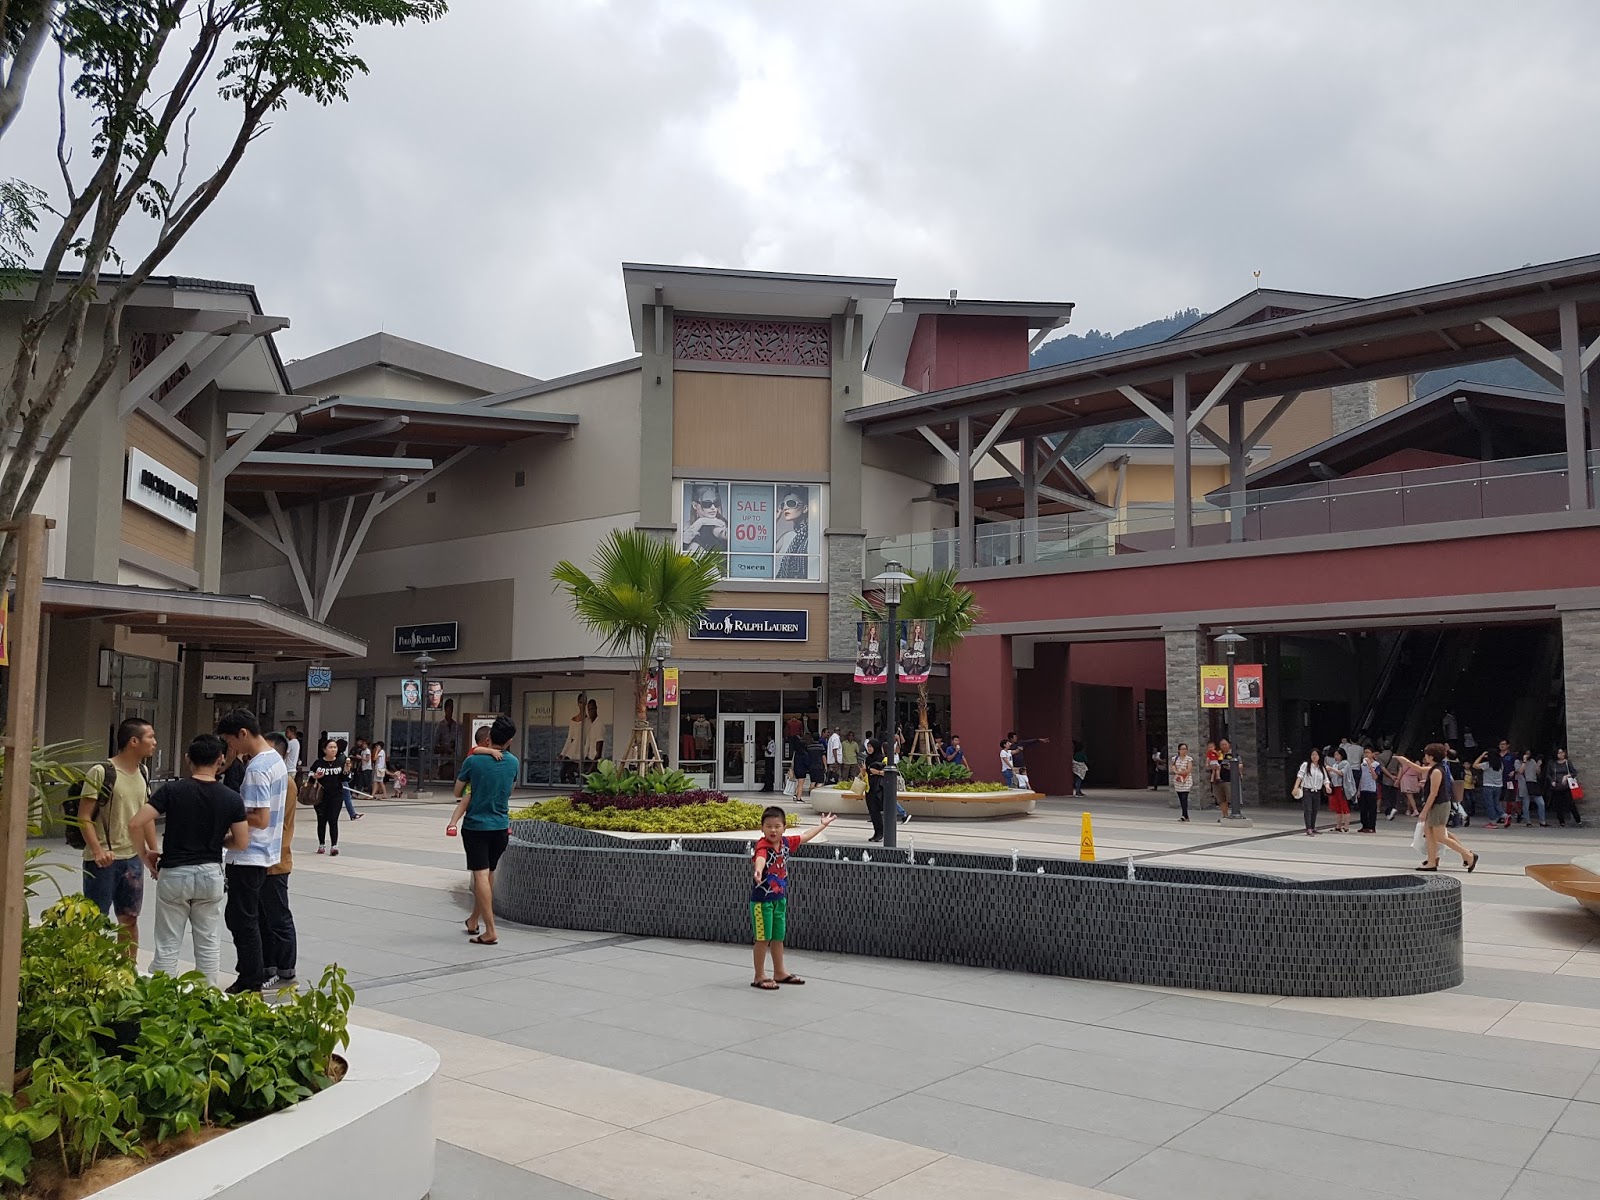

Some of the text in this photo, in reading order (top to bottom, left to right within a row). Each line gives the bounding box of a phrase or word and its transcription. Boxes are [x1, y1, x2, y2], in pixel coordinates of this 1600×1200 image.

[737, 500, 767, 512] SALE
[699, 619, 799, 632] POLO RALPH LAUREN
[398, 634, 451, 646] POLO RALPH LAUREN
